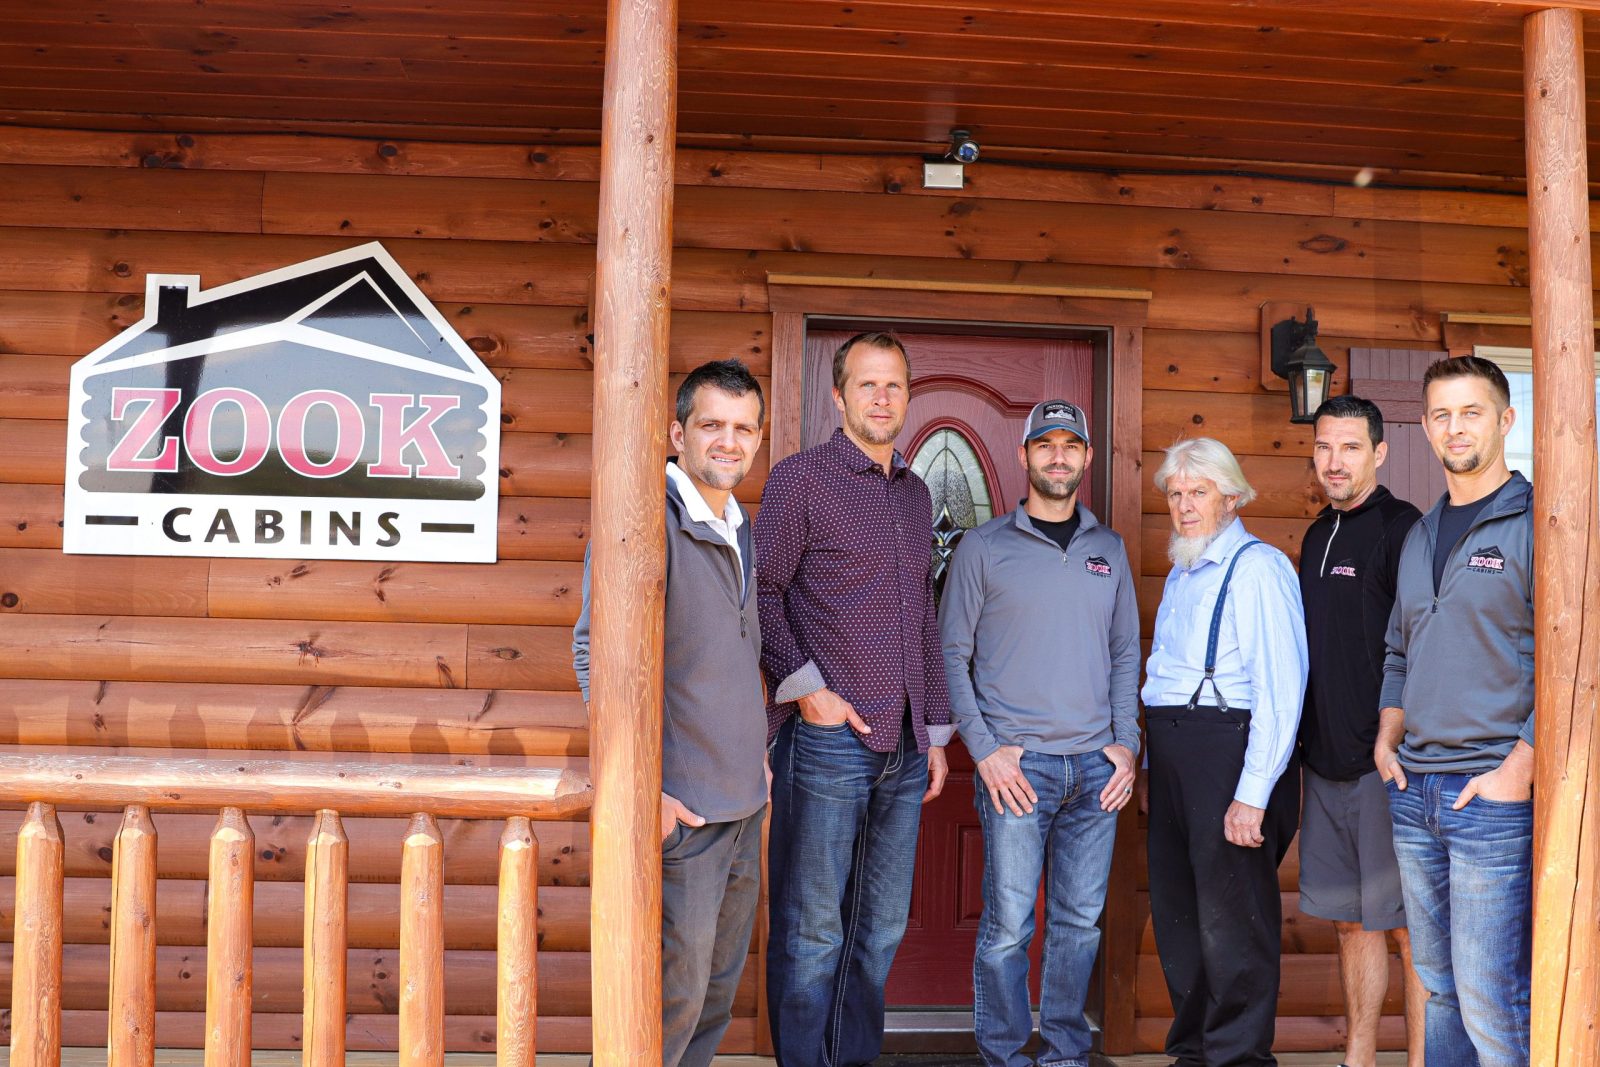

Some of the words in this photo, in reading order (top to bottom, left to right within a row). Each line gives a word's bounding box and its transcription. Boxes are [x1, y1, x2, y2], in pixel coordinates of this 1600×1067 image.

[106, 387, 461, 480] ZOOK
[161, 506, 402, 547] CABINS
[1469, 556, 1503, 569] ZOOK
